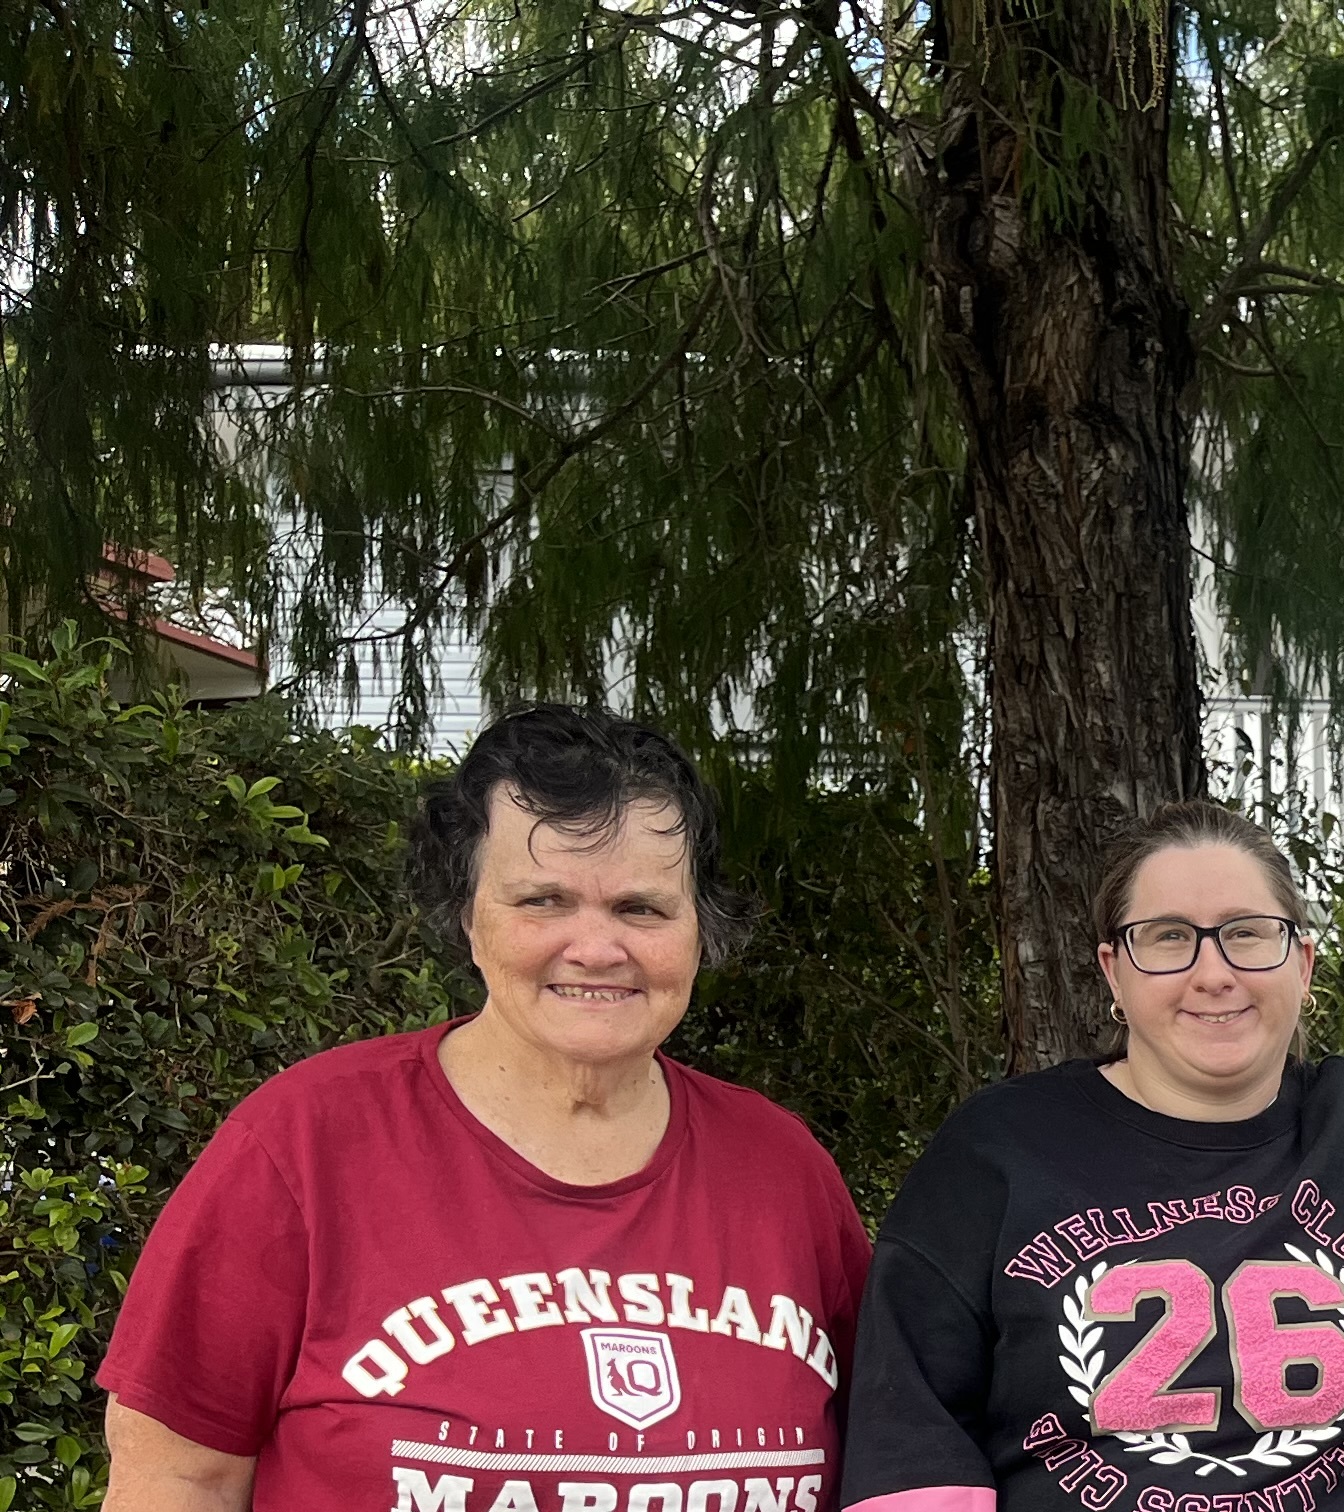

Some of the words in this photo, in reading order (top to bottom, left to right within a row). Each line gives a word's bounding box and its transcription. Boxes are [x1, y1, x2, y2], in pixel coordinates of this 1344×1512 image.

[341, 1267, 838, 1397] QUEENSLAND
[600, 1342, 658, 1355] MAROONS
[438, 1420, 564, 1449] STATE
[608, 1431, 646, 1452] OF
[687, 1427, 804, 1450] ORIGIN
